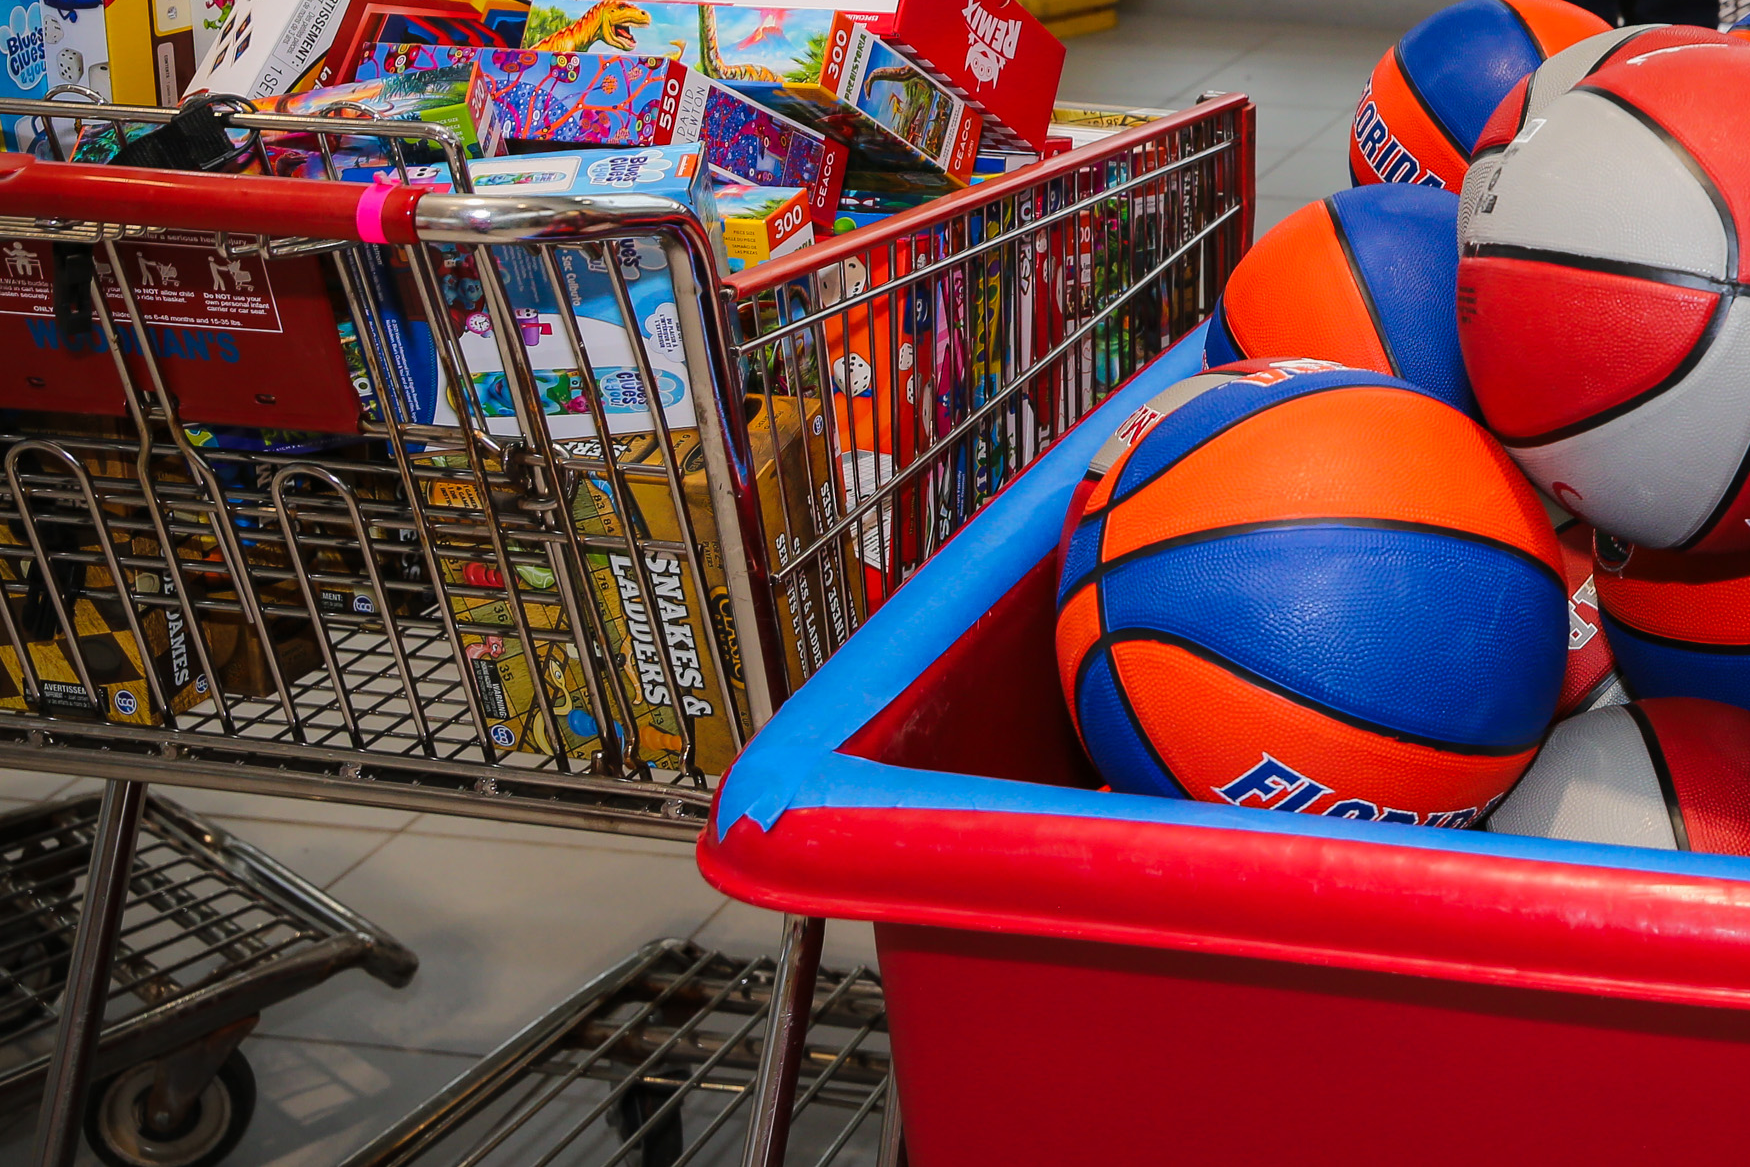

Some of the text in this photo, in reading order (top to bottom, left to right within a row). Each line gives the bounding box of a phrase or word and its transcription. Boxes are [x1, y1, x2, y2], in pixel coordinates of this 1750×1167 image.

[828, 29, 848, 80] 300
[844, 33, 867, 101] PREHISTORIA
[659, 78, 680, 131] 550
[676, 88, 694, 137] DAVID
[774, 204, 802, 239] 300
[220, 300, 249, 308] personal
[562, 255, 581, 307] Sac Culbuto
[593, 493, 606, 511] 83
[602, 517, 615, 534] 84
[493, 604, 509, 622] 36
[609, 552, 673, 707] LADDERS
[645, 551, 713, 718] SNAKES &
[500, 664, 514, 682] 35
